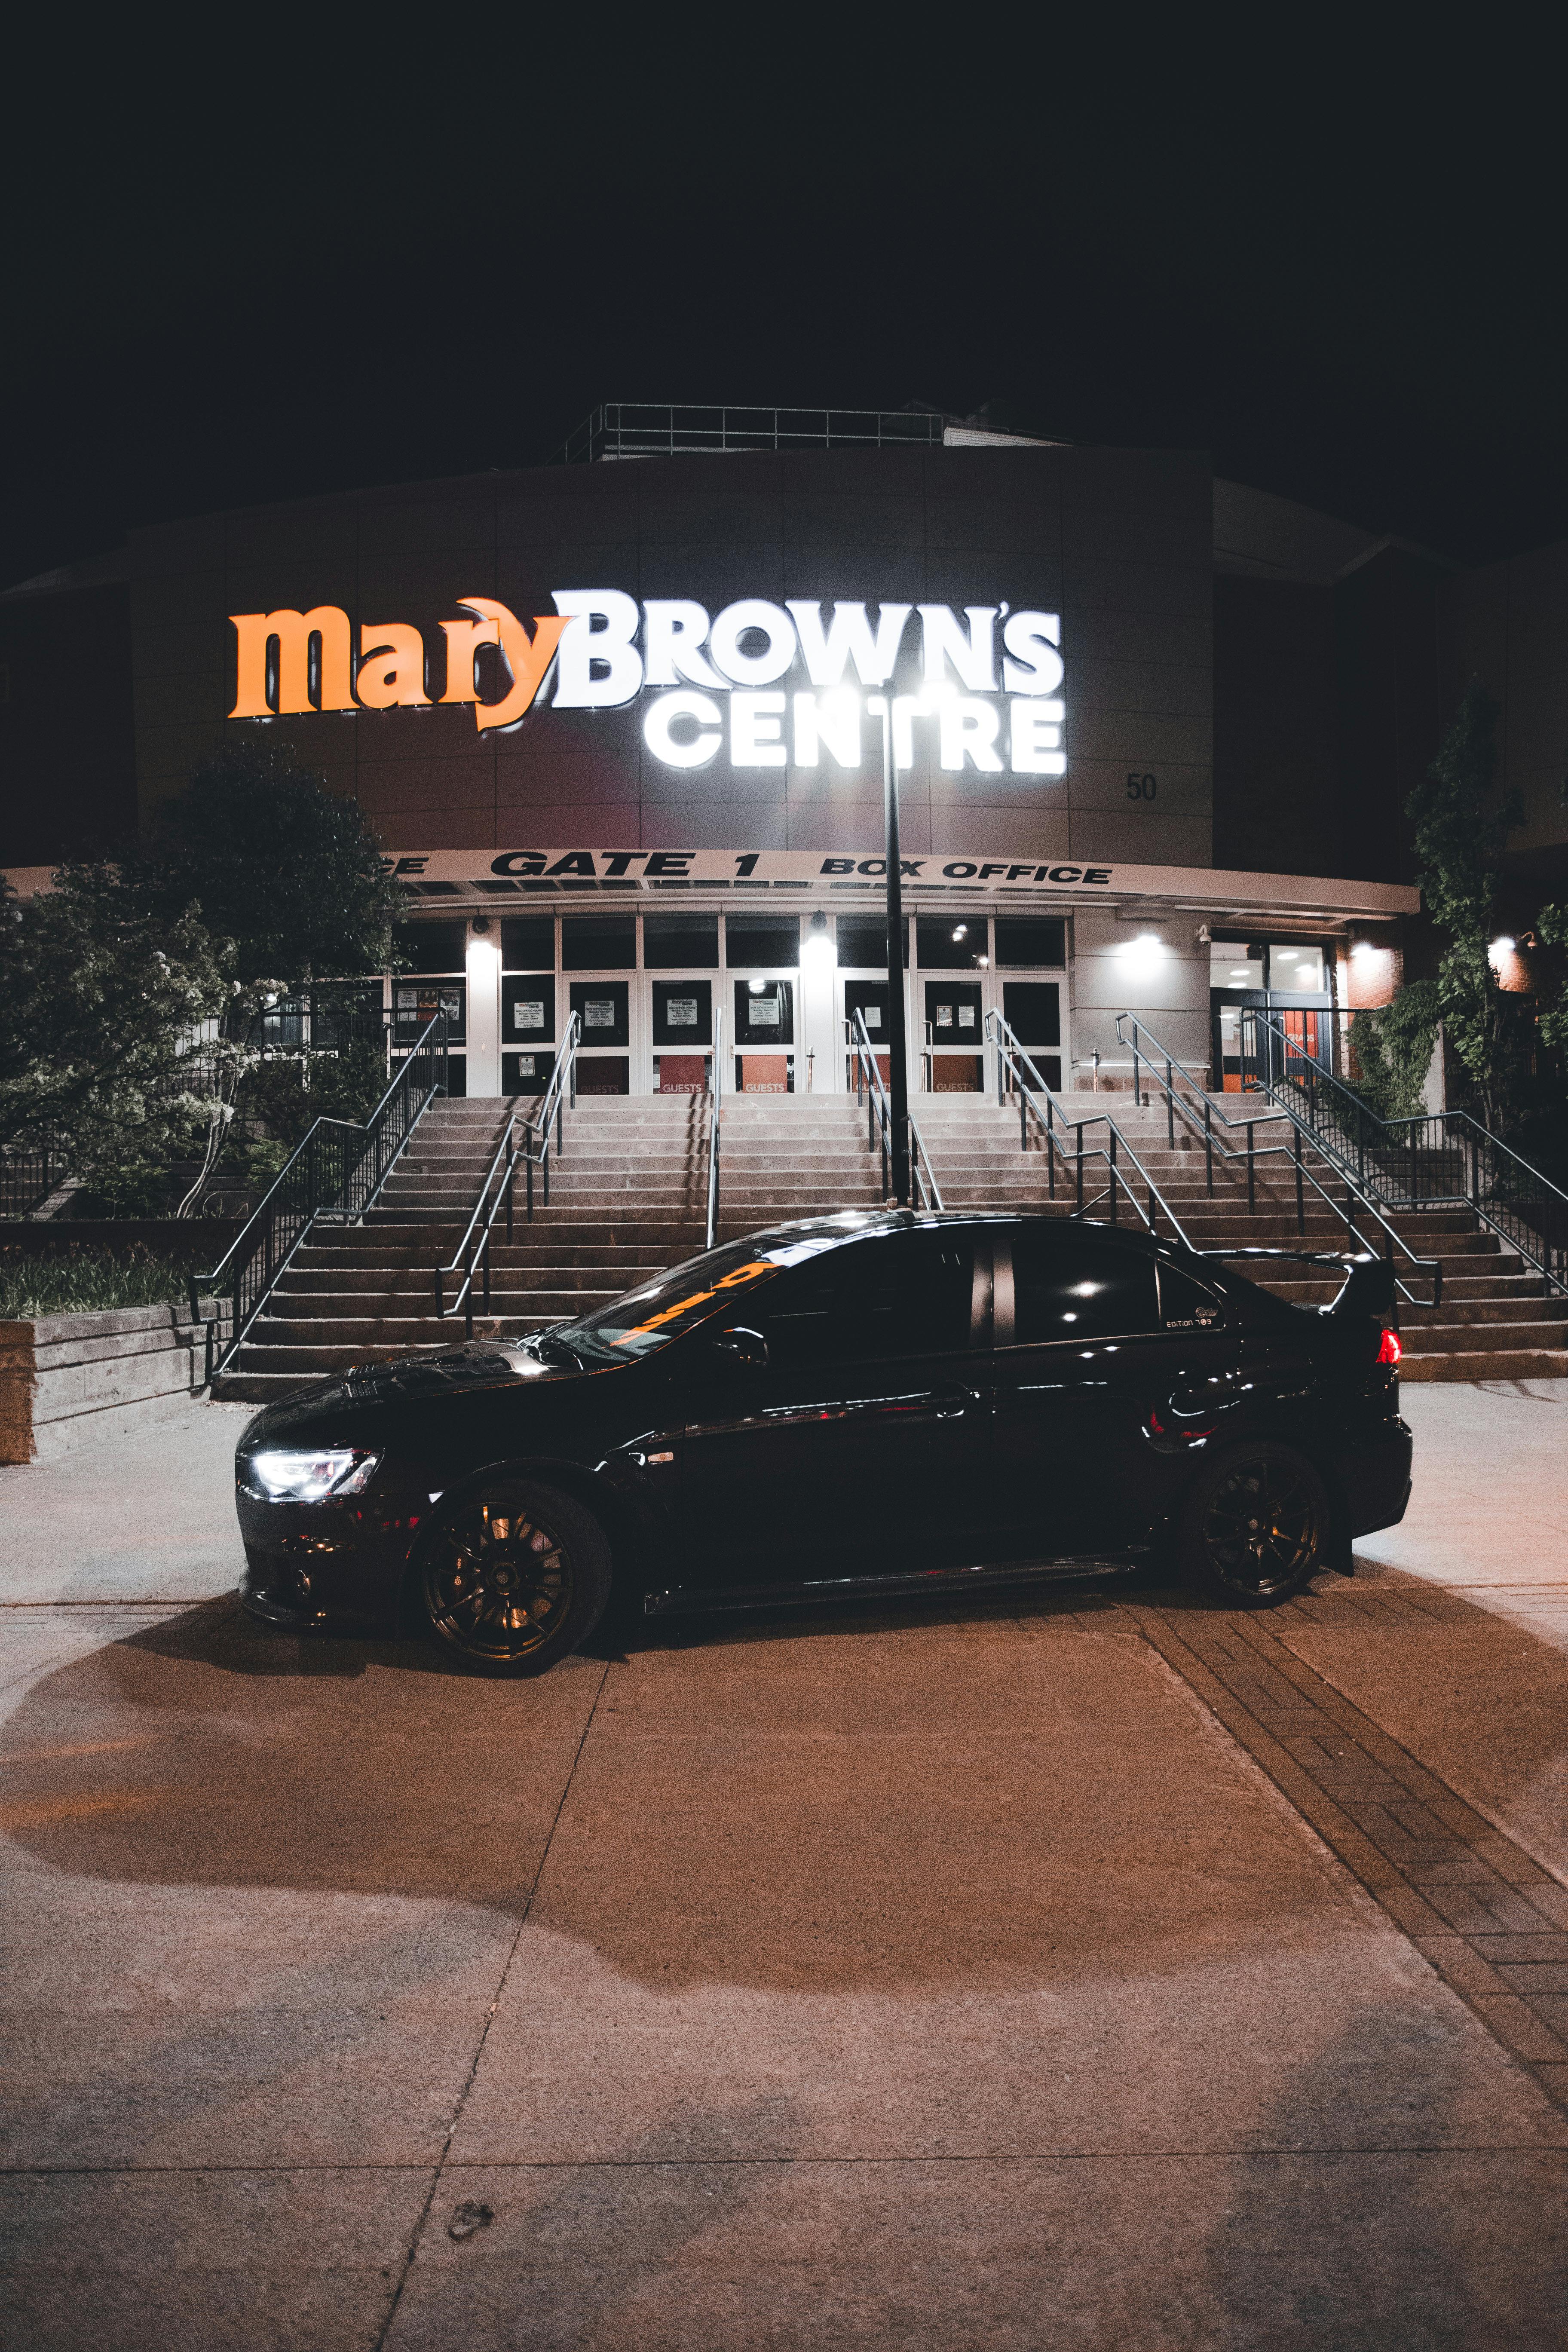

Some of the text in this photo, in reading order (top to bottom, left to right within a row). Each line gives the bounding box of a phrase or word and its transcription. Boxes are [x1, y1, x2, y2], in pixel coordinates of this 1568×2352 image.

[643, 690, 1066, 774] CENTRE
[1127, 773, 1157, 801] 50
[490, 851, 760, 877] GATE 1
[819, 858, 1113, 885] BOX OFFICE
[581, 1085, 619, 1093] GUESTS
[663, 1084, 702, 1093] GUESTS
[745, 1083, 784, 1092] GUESTS
[937, 1083, 974, 1092] GUESTS
